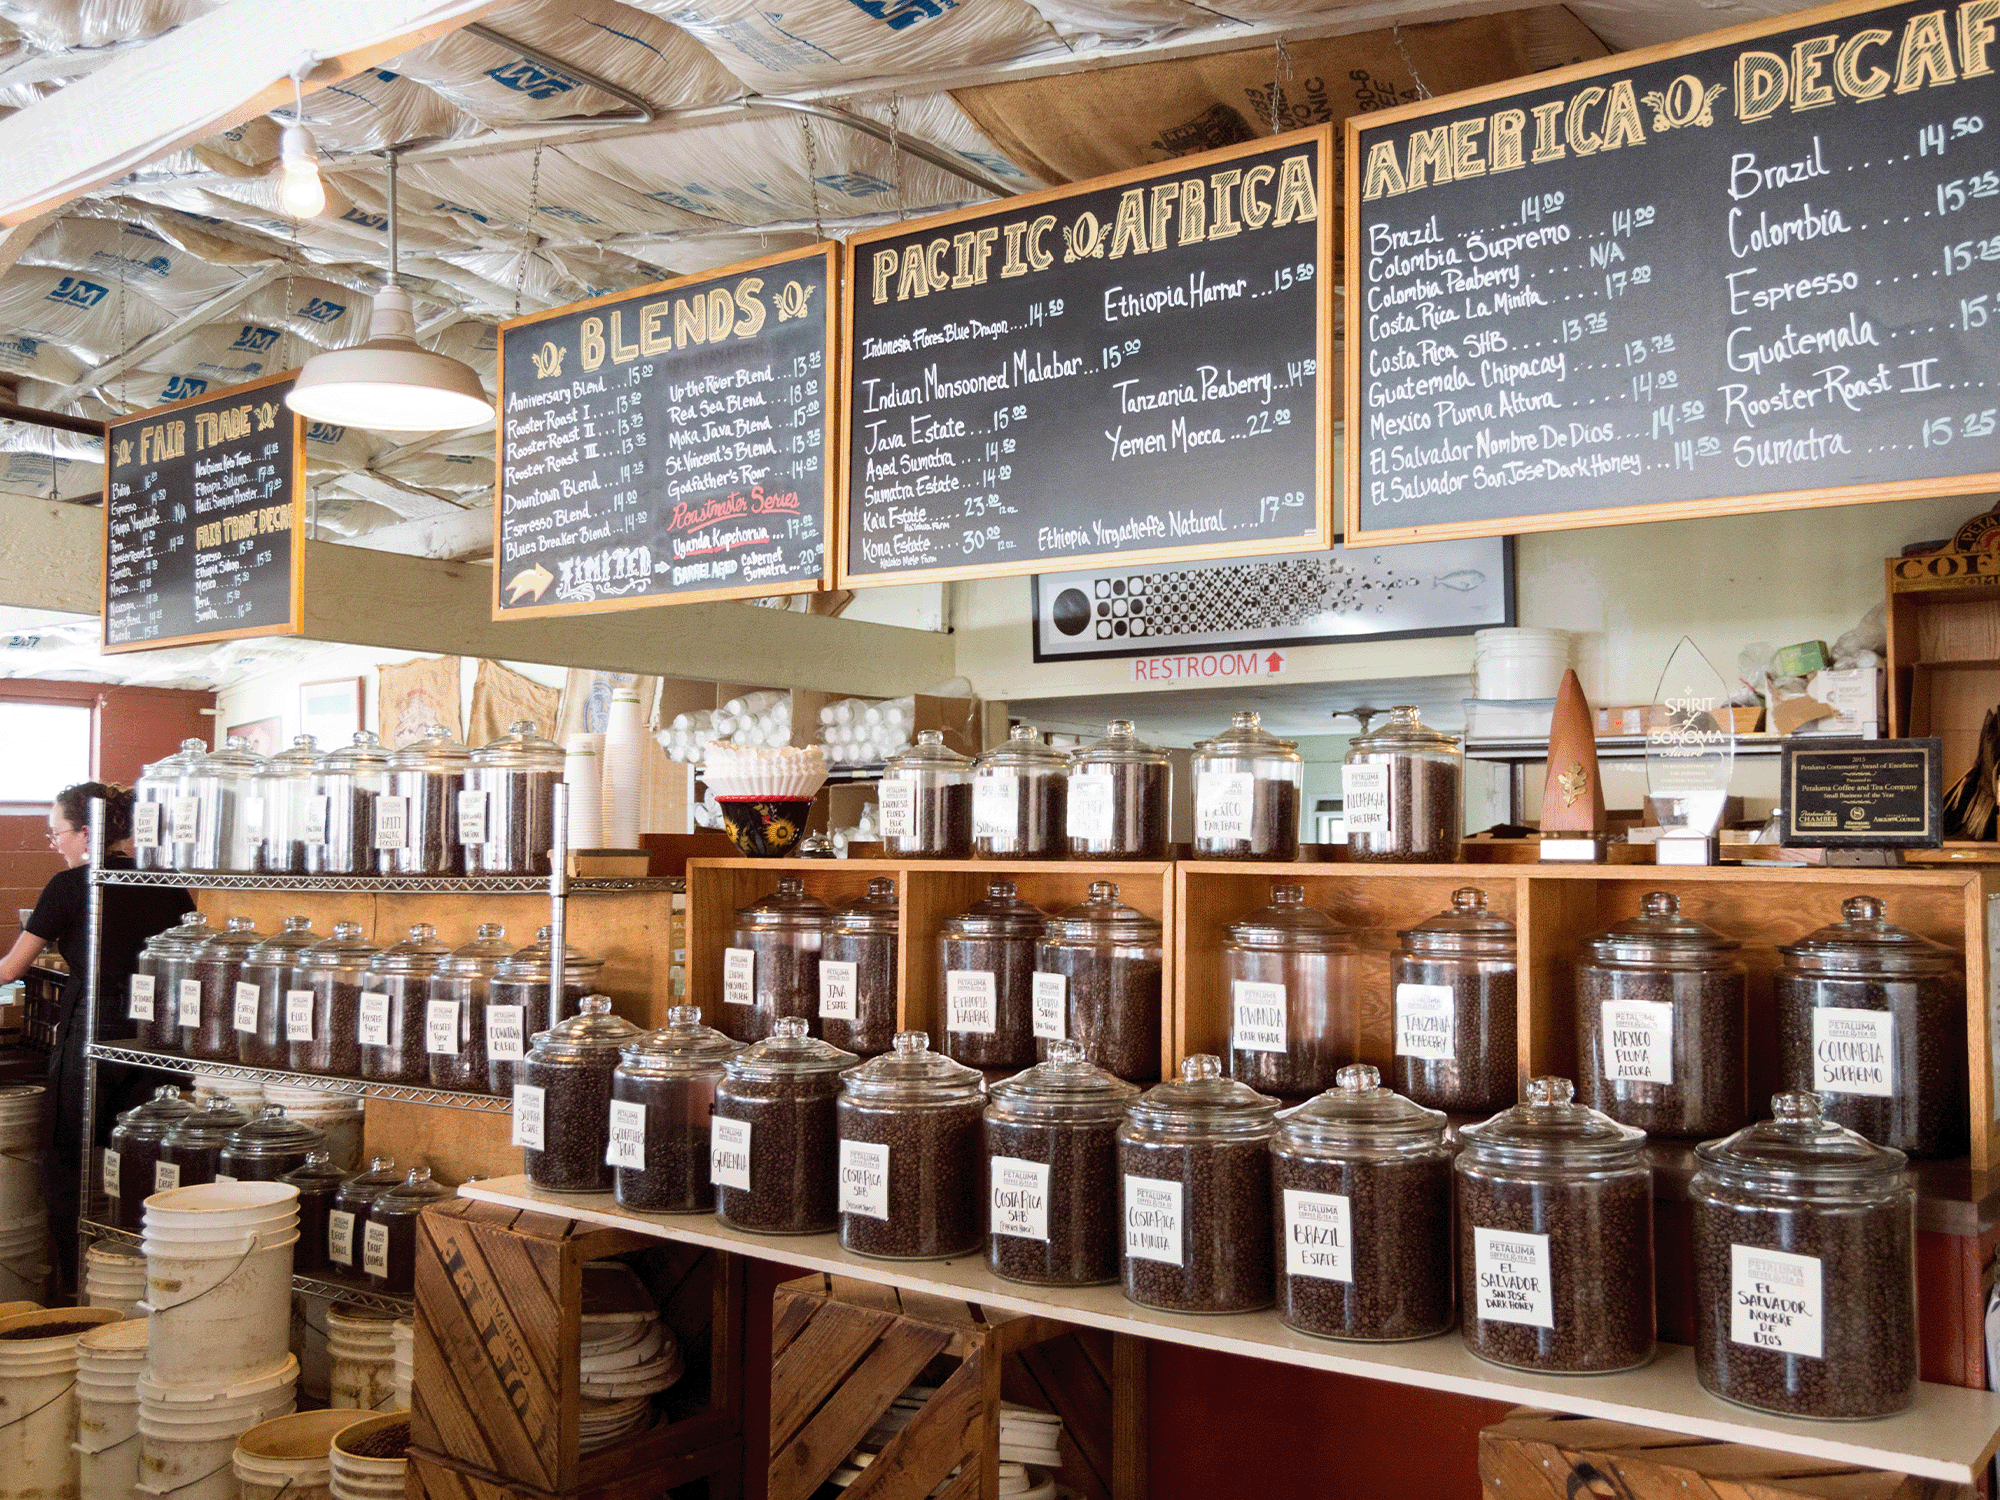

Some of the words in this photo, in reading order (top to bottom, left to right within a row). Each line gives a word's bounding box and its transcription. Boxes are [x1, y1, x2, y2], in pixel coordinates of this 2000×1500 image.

[1734, 1, 2000, 123] DECAF
[1362, 79, 1646, 202] AMERICA
[1727, 136, 1830, 200] Brazil
[1109, 155, 1318, 259] AFRICA
[1369, 215, 1444, 256] Brazil
[1728, 203, 1851, 258] Colombia
[872, 215, 1058, 304] PACIFIC
[1368, 248, 1462, 282] Colombia
[1466, 224, 1570, 262] Supremo
[1368, 279, 1443, 312] Colombia
[1441, 265, 1519, 294] Peaberry
[1590, 240, 1625, 269] N/A
[1725, 267, 1858, 314] Espresso
[1104, 286, 1188, 322] Ethiopia
[1190, 270, 1247, 309] Harrar
[1369, 312, 1420, 342] Costa
[1415, 302, 1460, 330] Rica
[1466, 298, 1491, 319] La
[1494, 284, 1548, 315] Minita
[580, 277, 767, 374] BLENDS
[862, 335, 912, 360] Indonesia
[912, 327, 946, 349] Flores
[943, 323, 970, 344] Blue
[969, 319, 1009, 341] Dragon
[1727, 312, 1879, 375] Guatemala
[507, 387, 572, 414] Anniversary
[572, 376, 607, 399] Blend
[684, 380, 705, 398] the
[704, 375, 734, 394] River
[735, 364, 774, 388] Blend
[862, 378, 923, 414] Indian
[924, 361, 1009, 402] Monsooned
[1013, 349, 1083, 387] Malabar
[1113, 379, 1198, 414] Tanzania
[1197, 365, 1272, 405] Peaberry
[1369, 365, 1475, 407] Guatemala
[1481, 352, 1565, 387] Chipacay
[1718, 382, 1822, 427] Rooster
[1812, 363, 1892, 411] Roast
[1898, 358, 1941, 393] II
[140, 420, 186, 466] FAIR
[195, 404, 253, 452] TRADE
[865, 420, 906, 455] Java
[911, 414, 966, 444] Estate
[1370, 412, 1431, 440] Mexico
[1433, 400, 1497, 428] Pluma
[1500, 392, 1561, 418] Altura
[1105, 425, 1167, 462] Yemen
[1172, 416, 1225, 454] Mocca
[1370, 447, 1389, 475] El
[1391, 438, 1473, 471] Salvador
[1476, 428, 1539, 459] Nombre
[1539, 424, 1568, 449] De
[1569, 422, 1613, 447] Dios
[1734, 428, 1851, 467] Sumatra
[503, 486, 561, 516] Downtown
[560, 470, 601, 498] Blend
[865, 480, 915, 507] Sumatra
[915, 474, 959, 496] Estate
[1371, 480, 1389, 506] El
[1391, 470, 1468, 503] Salvador
[1472, 465, 1507, 489] San
[1502, 460, 1545, 485] Jose
[1542, 456, 1591, 480] Dark
[1590, 453, 1641, 477] Honey
[503, 517, 553, 542] Espresso
[553, 501, 592, 527] Blend
[667, 491, 747, 532] Roastmaster
[751, 485, 800, 514] Series
[196, 522, 222, 550] FAIR
[222, 511, 258, 543] TRADE
[1038, 526, 1091, 551] Ethiopia
[1093, 514, 1166, 548] Yirgacheffe
[1168, 508, 1227, 538] Natural
[556, 545, 652, 601] LIMITED
[1134, 652, 1258, 681] RESTROOM
[1664, 697, 1715, 716] SPIRIT
[1651, 730, 1724, 745] SONOMA
[1802, 784, 1831, 792] Petaluma
[1884, 784, 1918, 792] Company
[828, 984, 846, 998] JAVA
[1240, 1006, 1283, 1028] RWANDA
[1401, 1013, 1450, 1033] TANZANIA
[1828, 1021, 1876, 1031] PETALUMA
[1404, 1032, 1447, 1052] PEABERRY
[1613, 1030, 1650, 1047] MEXICO
[1615, 1049, 1649, 1063] PLUMA
[1818, 1039, 1883, 1064] COLOMBIA
[1618, 1064, 1652, 1078] ALTURA
[1823, 1064, 1883, 1084] SUPREMO
[1129, 1206, 1156, 1227] COSTA
[1298, 1203, 1338, 1215] PETALUMA
[1128, 1231, 1138, 1247] LA
[1141, 1232, 1170, 1250] MINITA
[1294, 1223, 1345, 1248] BRAZIL
[1490, 1242, 1535, 1256] PETALUMA
[1301, 1250, 1339, 1267] ESTATE
[1500, 1263, 1517, 1273] EL
[1481, 1272, 1541, 1293] SALVADOR
[1492, 1289, 1506, 1298] SAN
[1507, 1290, 1527, 1301] JOSE
[1756, 1282, 1775, 1294] EL
[1486, 1299, 1508, 1308] DARK
[1509, 1301, 1533, 1312] HONEY
[1738, 1290, 1812, 1317] SALVADOR
[1749, 1309, 1794, 1327] NOMBRE
[1753, 1331, 1782, 1346] DIOS
[1760, 1322, 1777, 1332] DE
